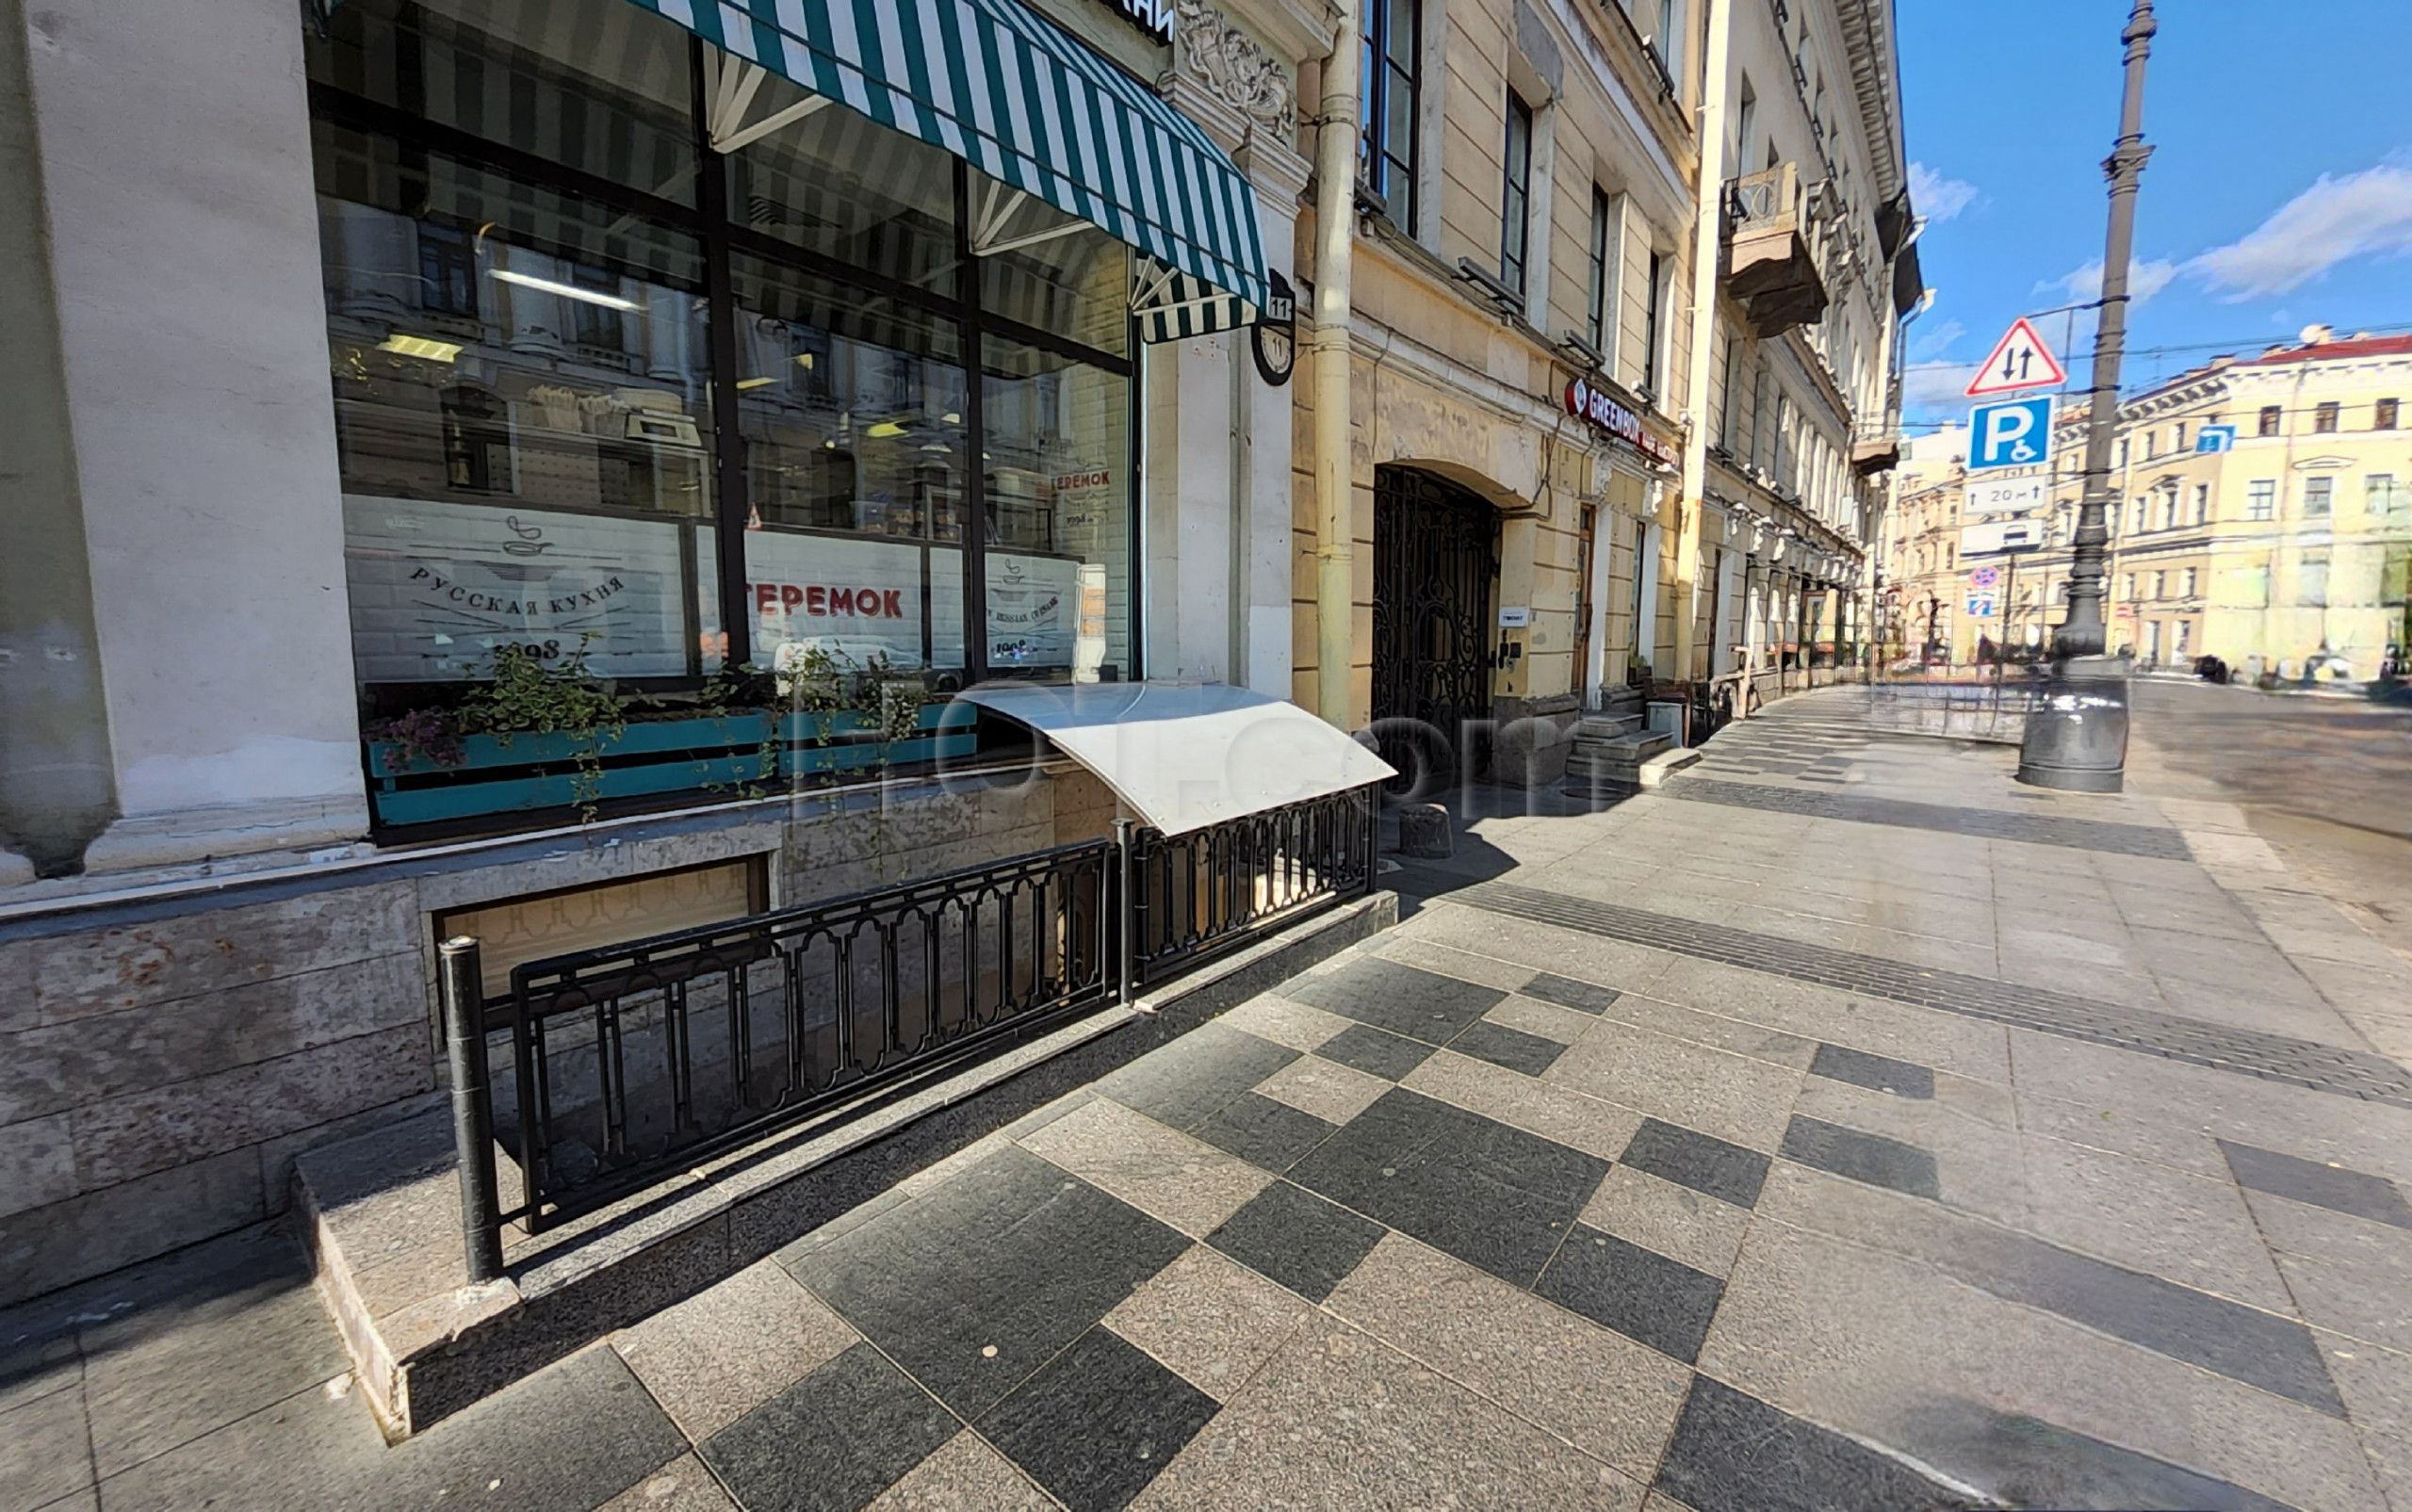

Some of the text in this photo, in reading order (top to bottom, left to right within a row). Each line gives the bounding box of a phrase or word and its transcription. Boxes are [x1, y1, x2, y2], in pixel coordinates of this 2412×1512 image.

[1589, 388, 1640, 445] GREENBOX
[410, 567, 625, 616] РУССКАЯ КУХНЯ
